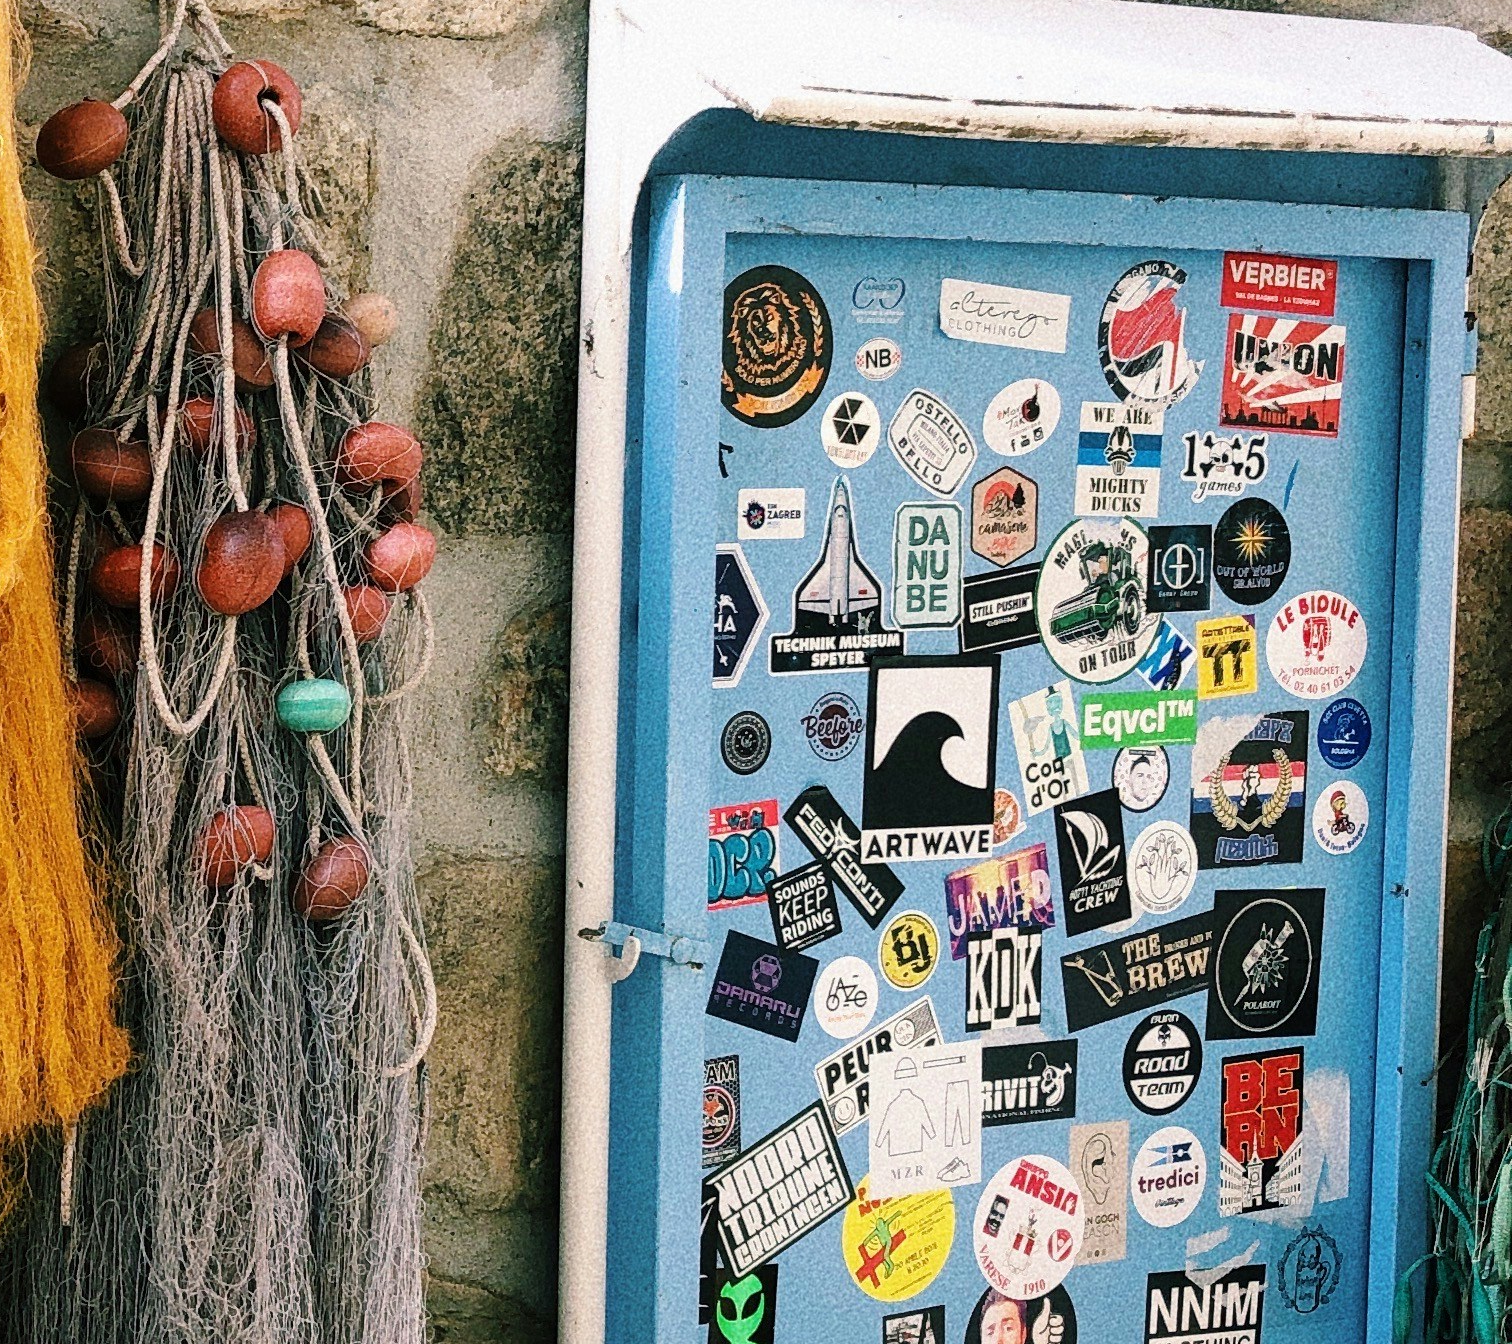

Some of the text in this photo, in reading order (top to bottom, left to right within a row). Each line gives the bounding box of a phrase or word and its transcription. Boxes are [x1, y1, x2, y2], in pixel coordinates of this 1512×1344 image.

[1230, 259, 1326, 290] VERBIER
[948, 318, 1017, 337] CLOTHING
[865, 348, 892, 369] NB
[915, 398, 968, 455] OSTELLO
[1093, 407, 1153, 425] WE ARE
[898, 437, 942, 485] BELLO
[1089, 477, 1149, 495] MIGHTY
[1195, 481, 1243, 499] games
[767, 510, 801, 520] ZAGREB
[1090, 496, 1142, 512] DUCKS
[908, 515, 951, 547] DA
[907, 550, 949, 581] NU
[906, 584, 948, 613] BE
[972, 602, 994, 620] STILL
[1276, 594, 1359, 632] LE BIDULE
[775, 633, 901, 653] TECHNIK MUSEUM
[1078, 641, 1137, 674] ON TOUR
[810, 651, 865, 668] SPEYER
[1292, 665, 1340, 676] PORNICHET
[1294, 681, 1305, 693] 02
[1306, 682, 1318, 694] 40
[1025, 757, 1066, 783] Coq
[1030, 779, 1071, 808] d'Or
[774, 872, 826, 905] SOUNDS
[1074, 887, 1120, 913] CREW
[779, 886, 829, 926] KEEP
[781, 908, 834, 943] RIDING
[1122, 933, 1161, 965] THE
[967, 928, 1042, 1028] KDK
[1127, 946, 1211, 996] BREW
[712, 994, 798, 1029] RECORDS
[716, 981, 802, 1019] DAMARU
[824, 1030, 893, 1097] PEUR
[713, 1115, 829, 1220] NOORD
[1138, 1165, 1200, 1194] tredici
[725, 1151, 837, 1245] TRIBUNE
[1010, 1166, 1078, 1216] ANSIA
[1095, 1212, 1119, 1225] GOGH
[979, 1244, 1011, 1291] VARESE
[1023, 1279, 1046, 1295] 1910
